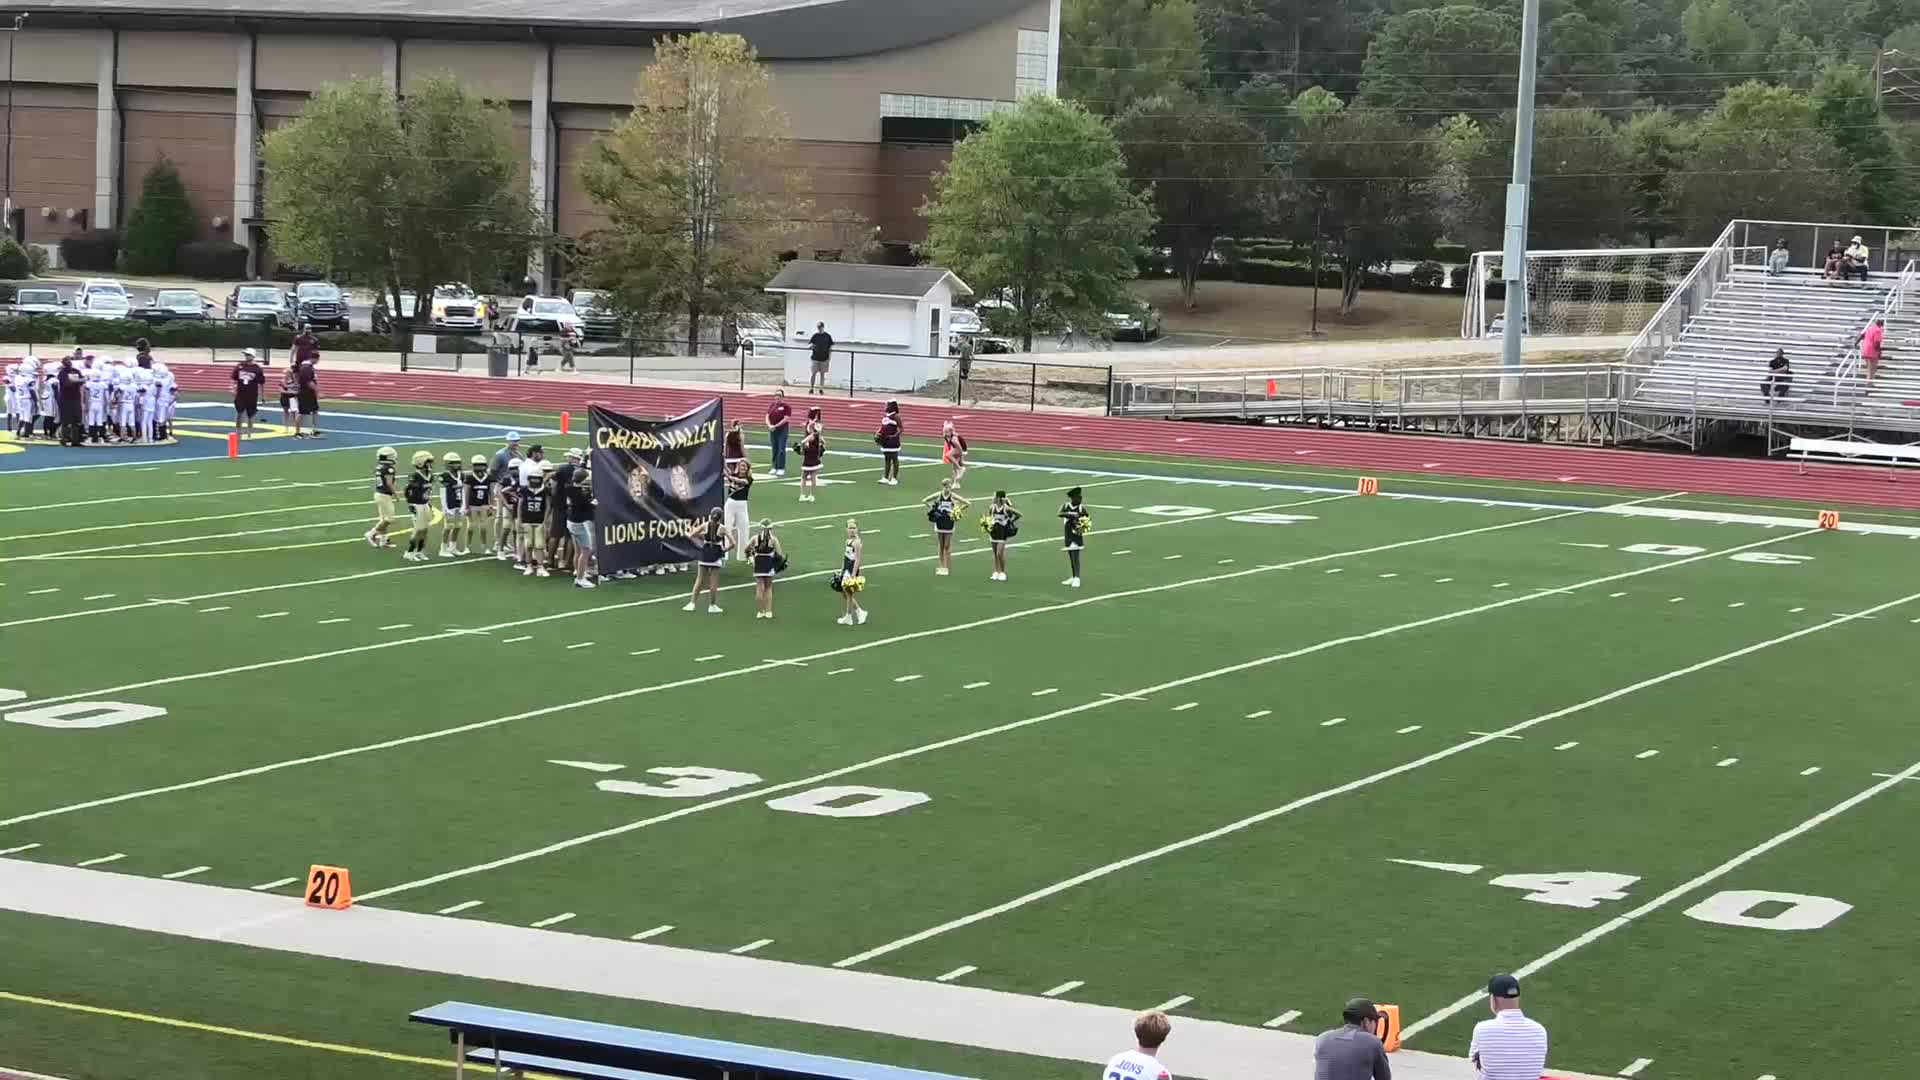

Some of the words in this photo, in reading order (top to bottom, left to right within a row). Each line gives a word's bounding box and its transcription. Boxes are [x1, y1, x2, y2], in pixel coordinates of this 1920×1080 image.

[596, 426, 663, 450] CAHABA
[660, 419, 718, 449] VALLEY
[1361, 479, 1373, 493] 10
[604, 520, 645, 545] LIONS
[649, 515, 713, 539] FOOTBA
[1820, 512, 1835, 528] 20
[0, 688, 169, 728] 0
[596, 765, 932, 818] 30
[307, 870, 340, 904] 20
[1489, 870, 1855, 931] 40
[1376, 1010, 1389, 1042] 0
